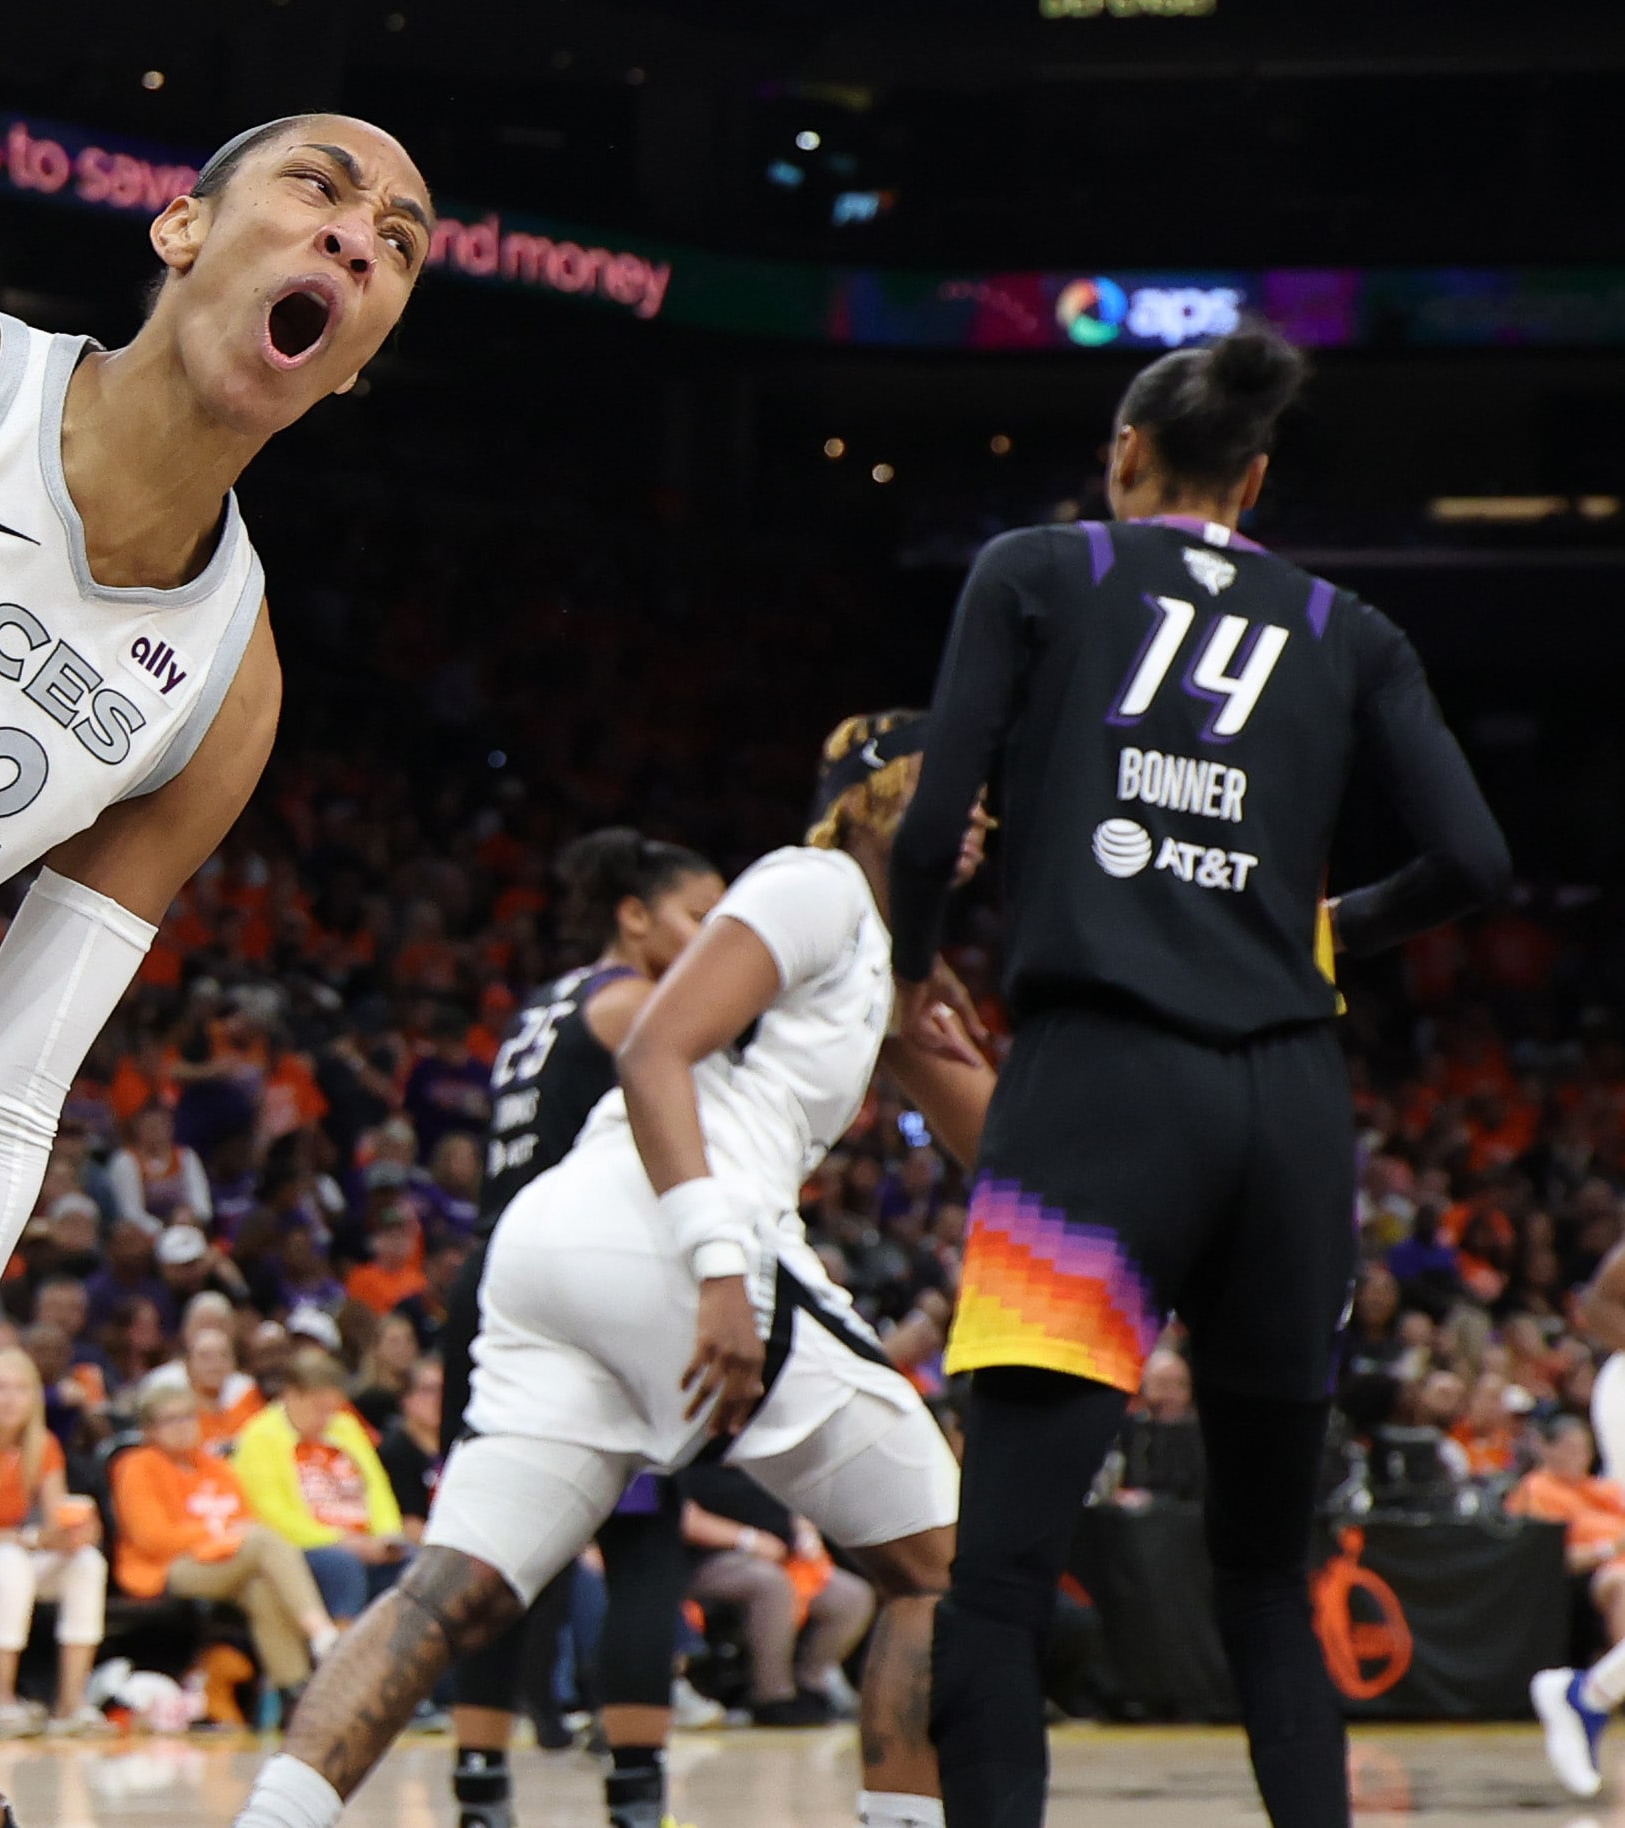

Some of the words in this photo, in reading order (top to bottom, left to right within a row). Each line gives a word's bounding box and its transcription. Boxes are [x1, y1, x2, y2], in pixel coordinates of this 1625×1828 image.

[6, 122, 70, 193] to
[426, 212, 500, 276] nd
[501, 232, 672, 318] money
[130, 636, 188, 695] ally
[1106, 594, 1289, 744] 14
[1117, 747, 1247, 823] BONNER
[1154, 836, 1258, 892] AT&T
